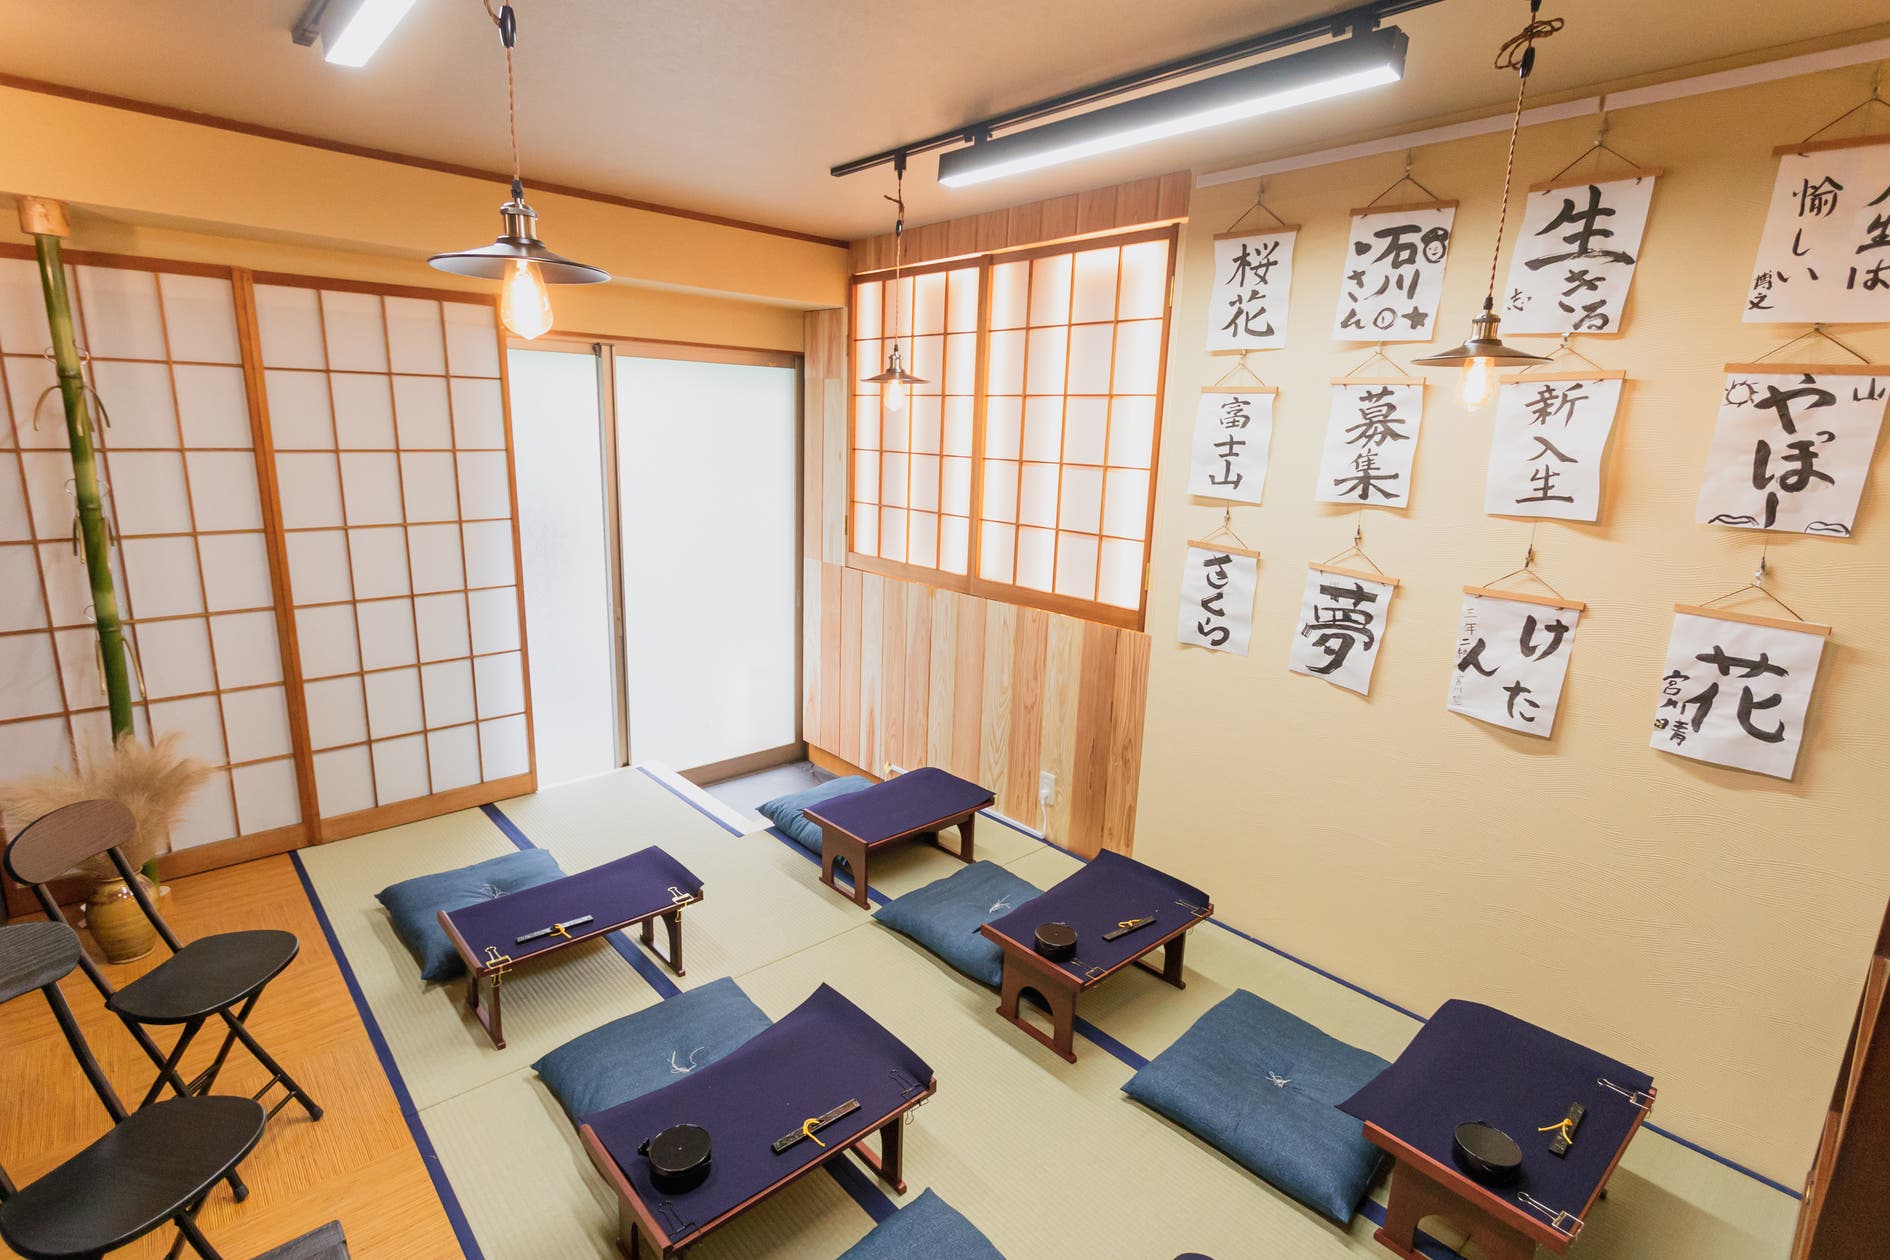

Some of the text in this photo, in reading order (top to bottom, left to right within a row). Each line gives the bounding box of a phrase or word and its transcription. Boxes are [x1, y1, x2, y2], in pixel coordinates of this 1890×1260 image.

[1525, 184, 1636, 331] 生きる
[1777, 176, 1843, 283] 愉しい
[1221, 241, 1281, 338] 桜花
[1208, 397, 1251, 490] 富士山
[1333, 386, 1410, 500] 募集
[1515, 382, 1589, 504] 新入生
[1197, 554, 1233, 647] さくら
[1302, 582, 1378, 675] 夢
[1684, 645, 1790, 744] 花
